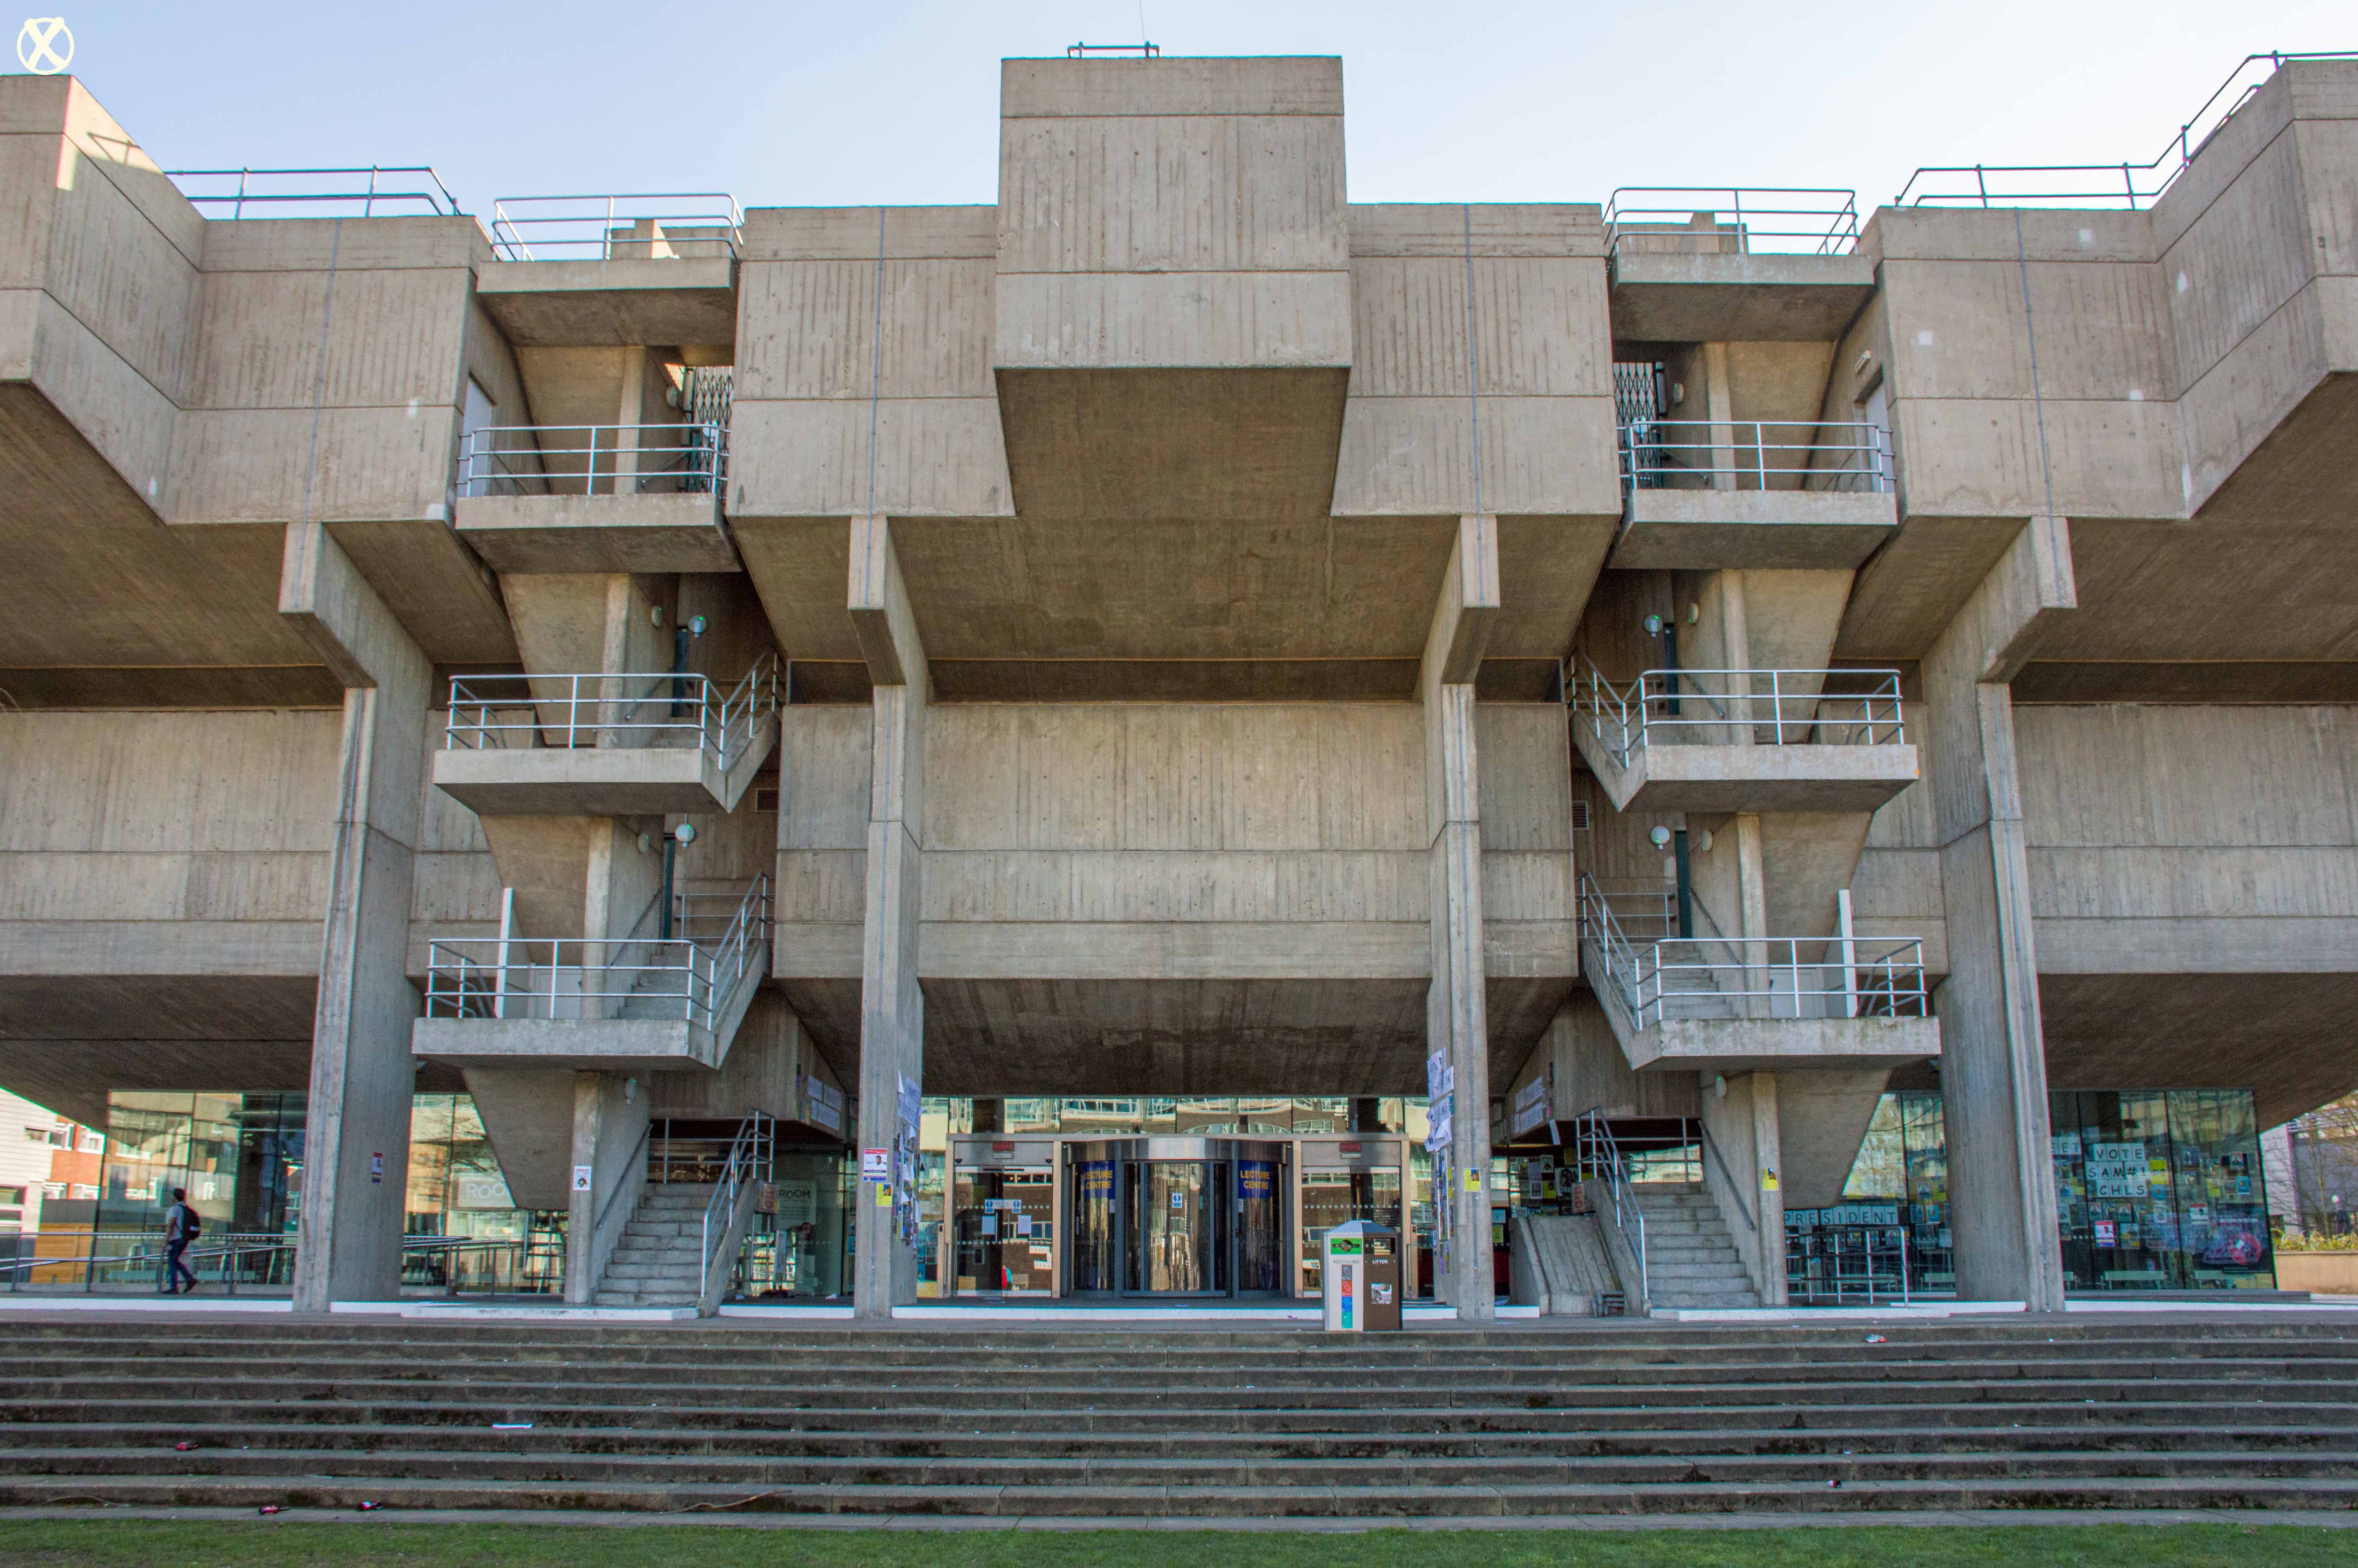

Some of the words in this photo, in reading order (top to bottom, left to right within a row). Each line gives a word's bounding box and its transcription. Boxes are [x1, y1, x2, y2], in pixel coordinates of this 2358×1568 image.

[2096, 1149, 2142, 1159] VOTE
[1084, 1171, 1113, 1179] LECTURE
[1240, 1171, 1270, 1179] LECTURE
[1086, 1181, 1111, 1189] CENTRE
[1244, 1181, 1269, 1189] CENTRE
[468, 1183, 507, 1197] ROO
[779, 1189, 811, 1198] ROOM
[2099, 1185, 2145, 1195] CHLS
[1784, 1212, 1895, 1224] PRESIDENT
